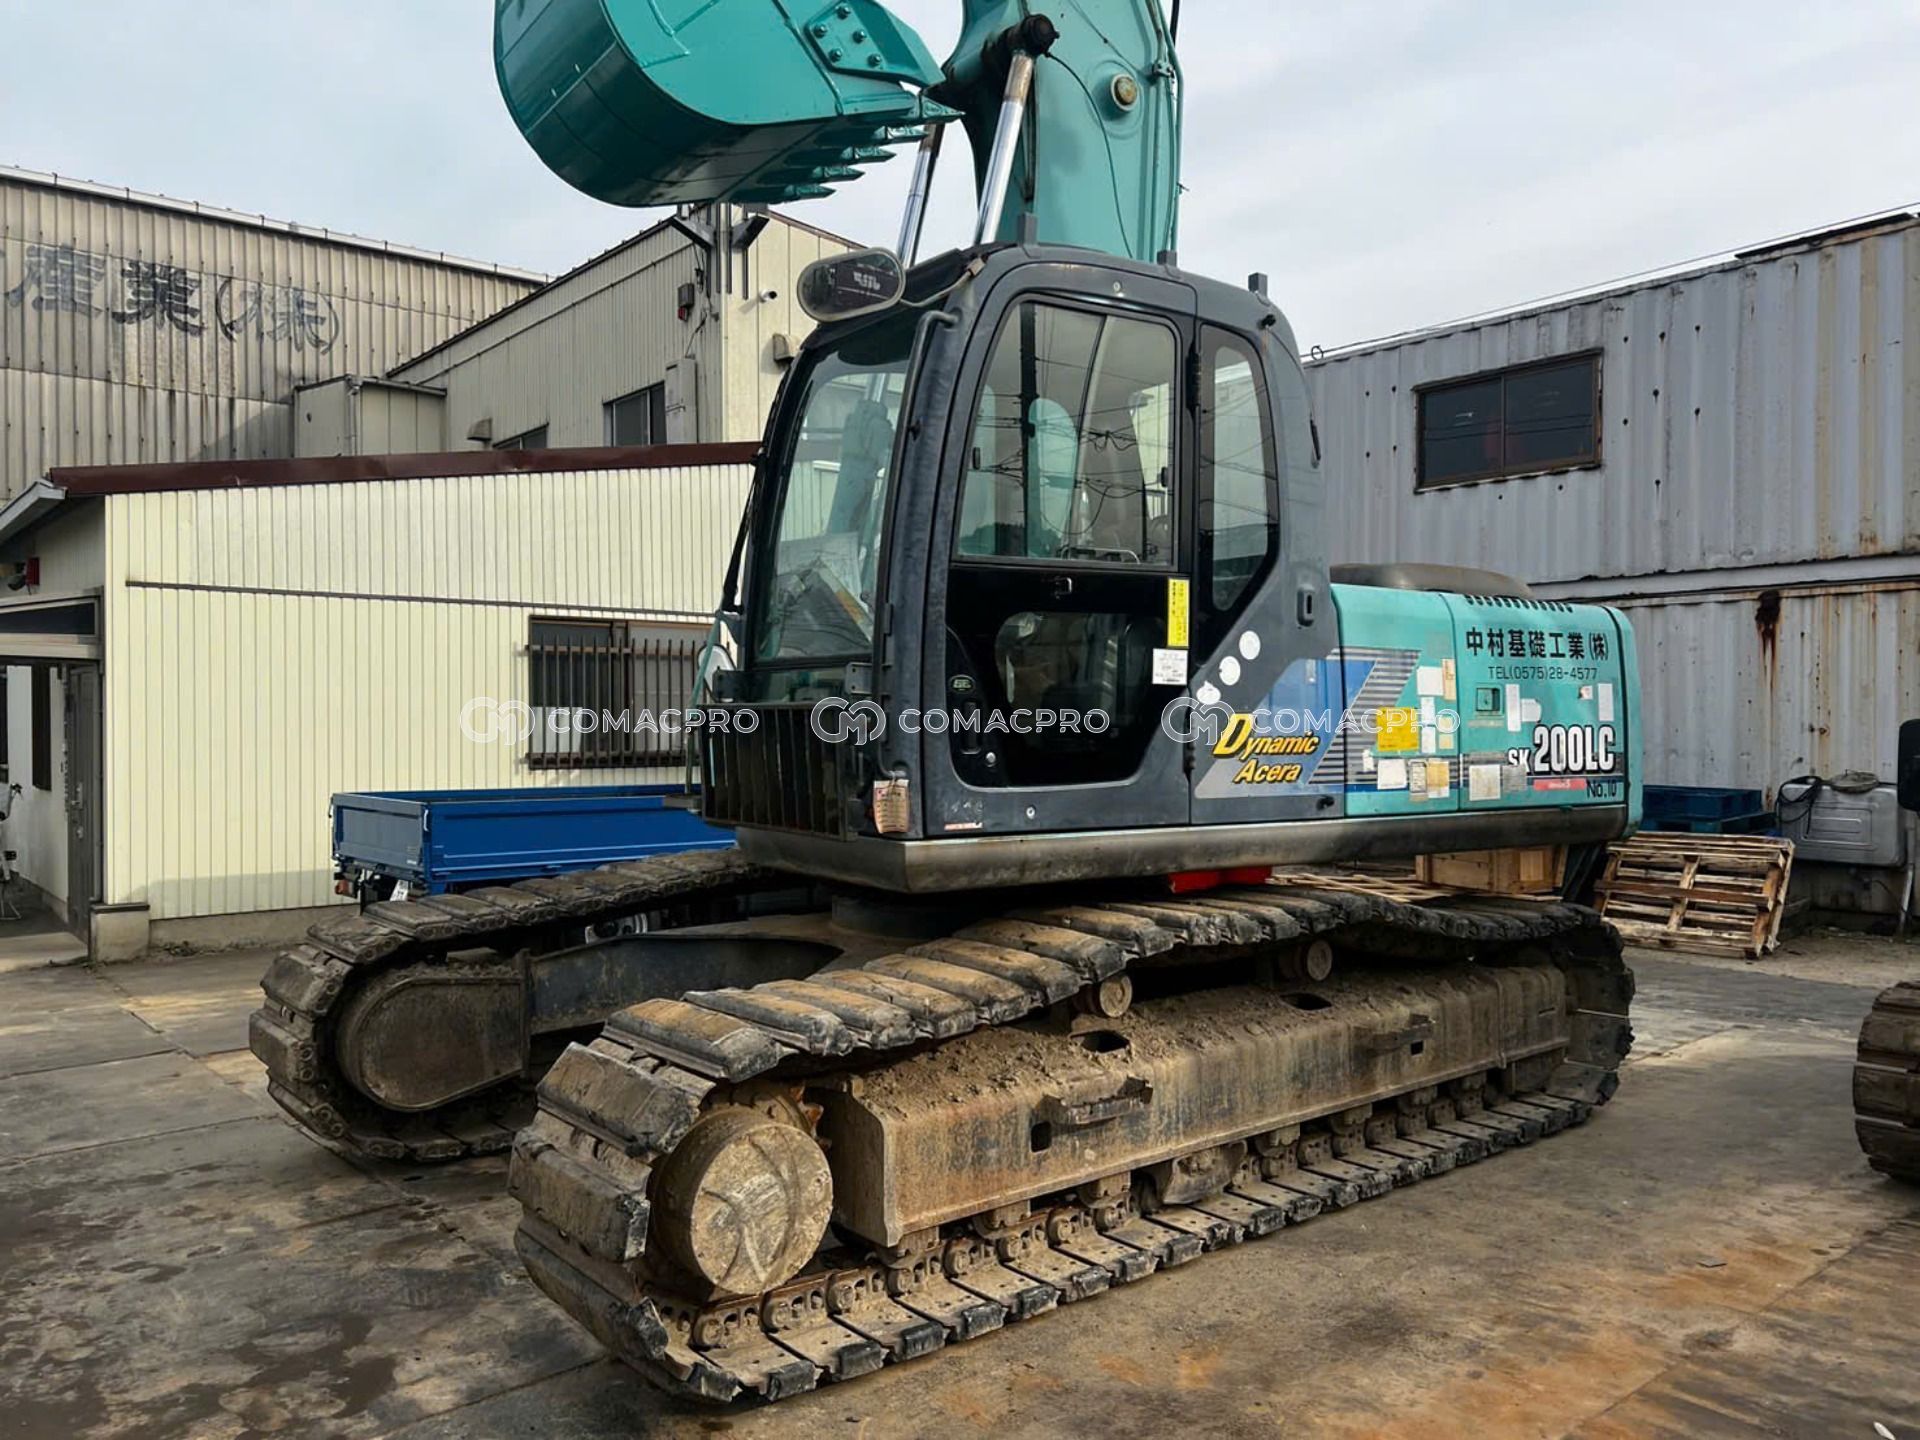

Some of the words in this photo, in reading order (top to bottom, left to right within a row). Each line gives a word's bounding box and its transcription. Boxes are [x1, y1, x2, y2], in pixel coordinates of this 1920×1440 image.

[1465, 626, 1609, 661] 中村基礎工業(株)
[1488, 666, 1597, 680] TEL(0575)28-4577
[1212, 712, 1321, 762] Dynamic
[1232, 758, 1303, 784] Acera
